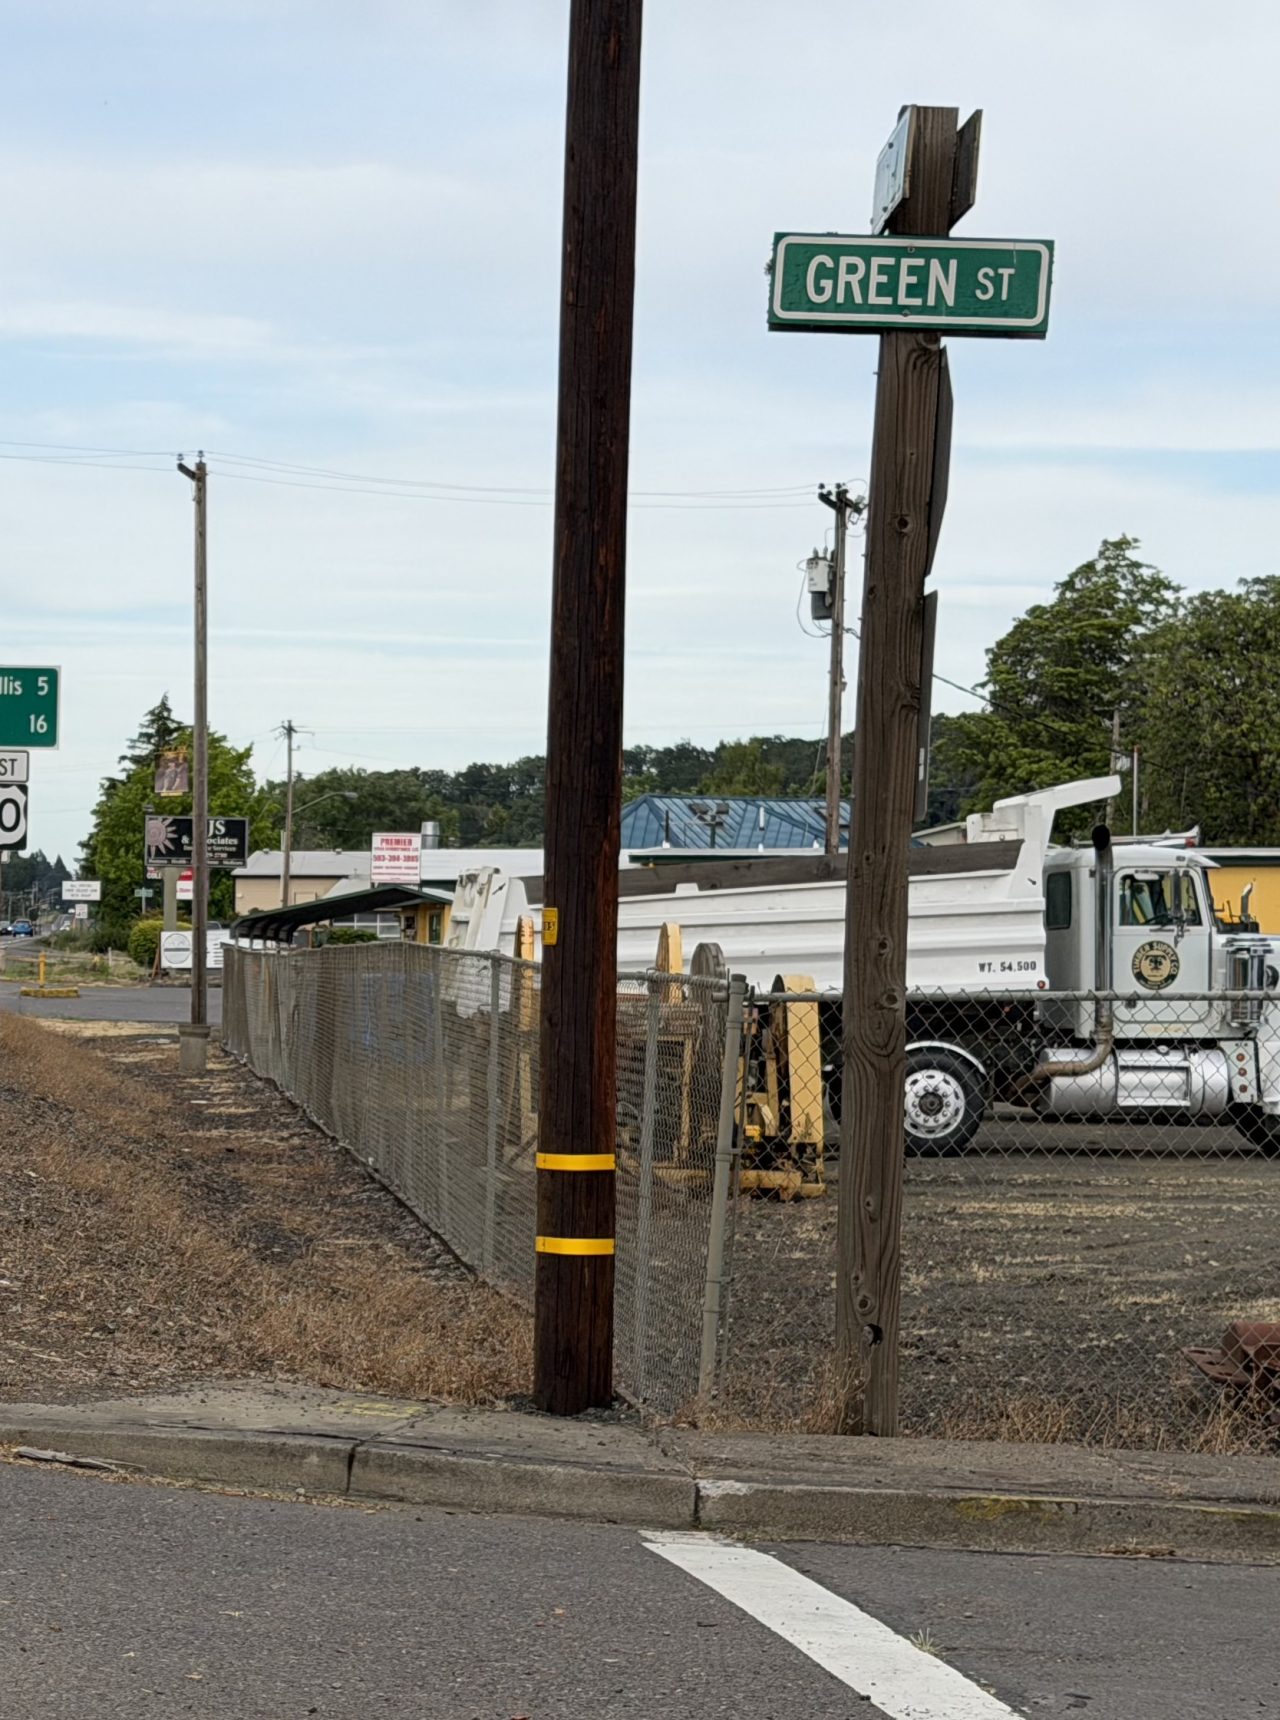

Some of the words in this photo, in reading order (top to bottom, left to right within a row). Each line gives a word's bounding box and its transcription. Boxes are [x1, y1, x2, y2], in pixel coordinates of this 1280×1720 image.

[806, 254, 958, 307] GREEN
[975, 267, 1016, 301] ST
[37, 676, 49, 696] 5
[29, 713, 48, 734] 16
[380, 838, 413, 847] PREMIER
[978, 962, 996, 973] WT.
[1133, 944, 1151, 974] TIMBER
[1152, 941, 1178, 961] SUPPLY
